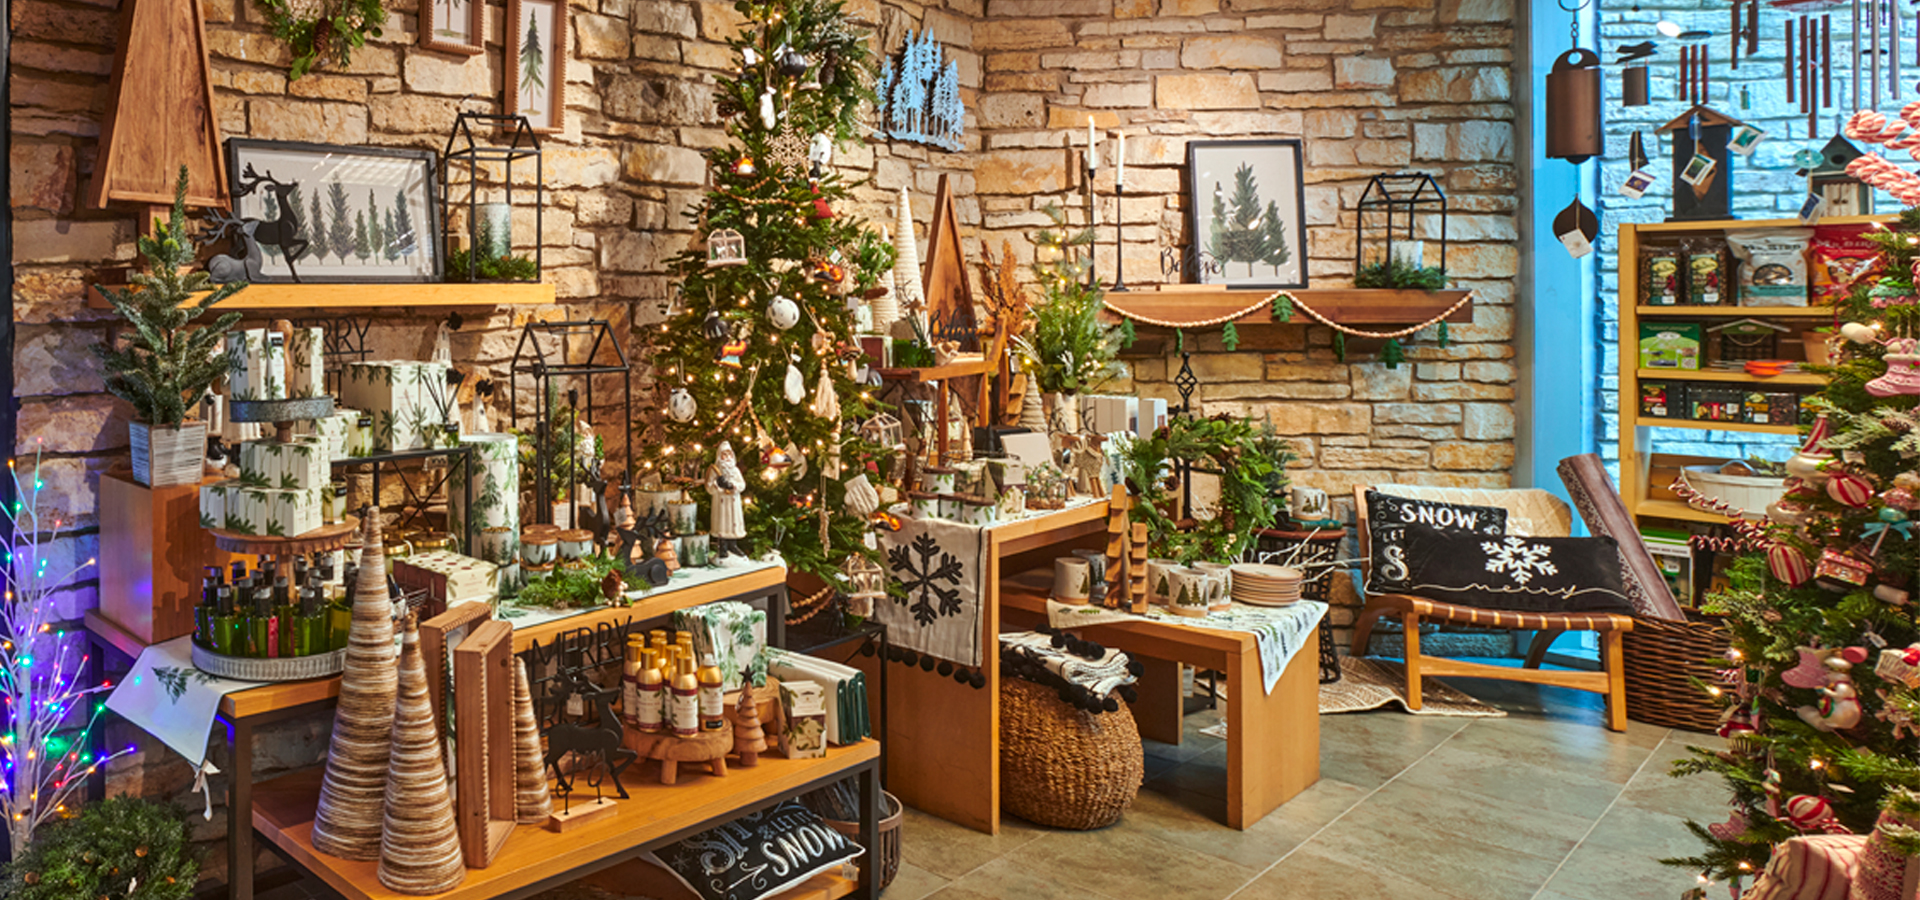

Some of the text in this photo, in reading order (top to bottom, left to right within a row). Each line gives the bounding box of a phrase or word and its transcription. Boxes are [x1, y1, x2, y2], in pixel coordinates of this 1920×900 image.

[1382, 528, 1405, 543] LET
[1400, 502, 1479, 530] SNOW
[532, 615, 632, 683] MERRY
[760, 822, 845, 877] SNOW
